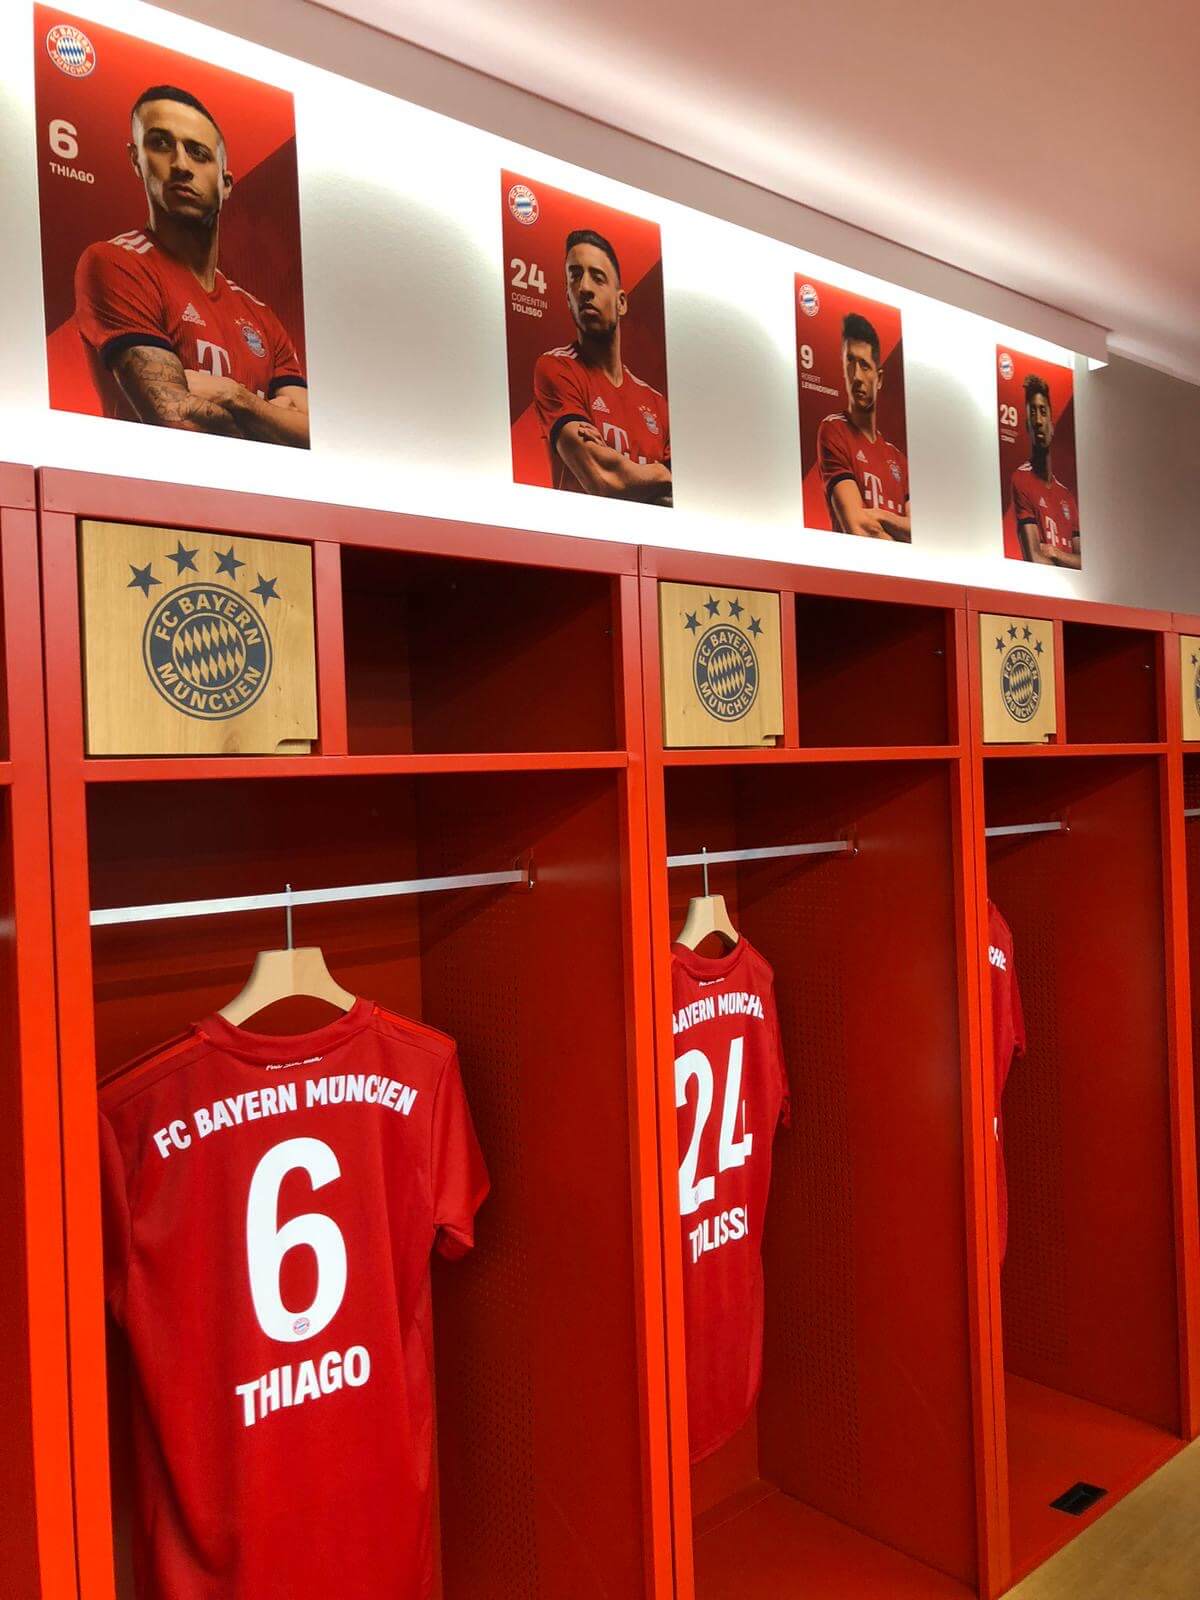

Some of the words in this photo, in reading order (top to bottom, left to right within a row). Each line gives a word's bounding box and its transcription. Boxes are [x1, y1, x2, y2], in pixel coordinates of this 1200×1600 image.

[49, 119, 79, 159] 6
[49, 161, 95, 184] THIAGO
[510, 258, 547, 295] 24
[511, 291, 548, 309] CORENTIN
[511, 302, 543, 318] TOLISSO
[800, 344, 814, 370] 9
[1000, 404, 1018, 427] 29
[155, 611, 178, 641] FC
[178, 593, 261, 645] BAYERN
[699, 645, 711, 667] FC
[710, 631, 753, 667] BAYERN
[157, 662, 262, 711] MÜNCHEN
[153, 1120, 191, 1159] FC
[193, 1082, 298, 1139] BAYERN
[674, 1036, 753, 1215] 24
[247, 1137, 347, 1342] 6
[235, 1345, 371, 1427] THIAGO
